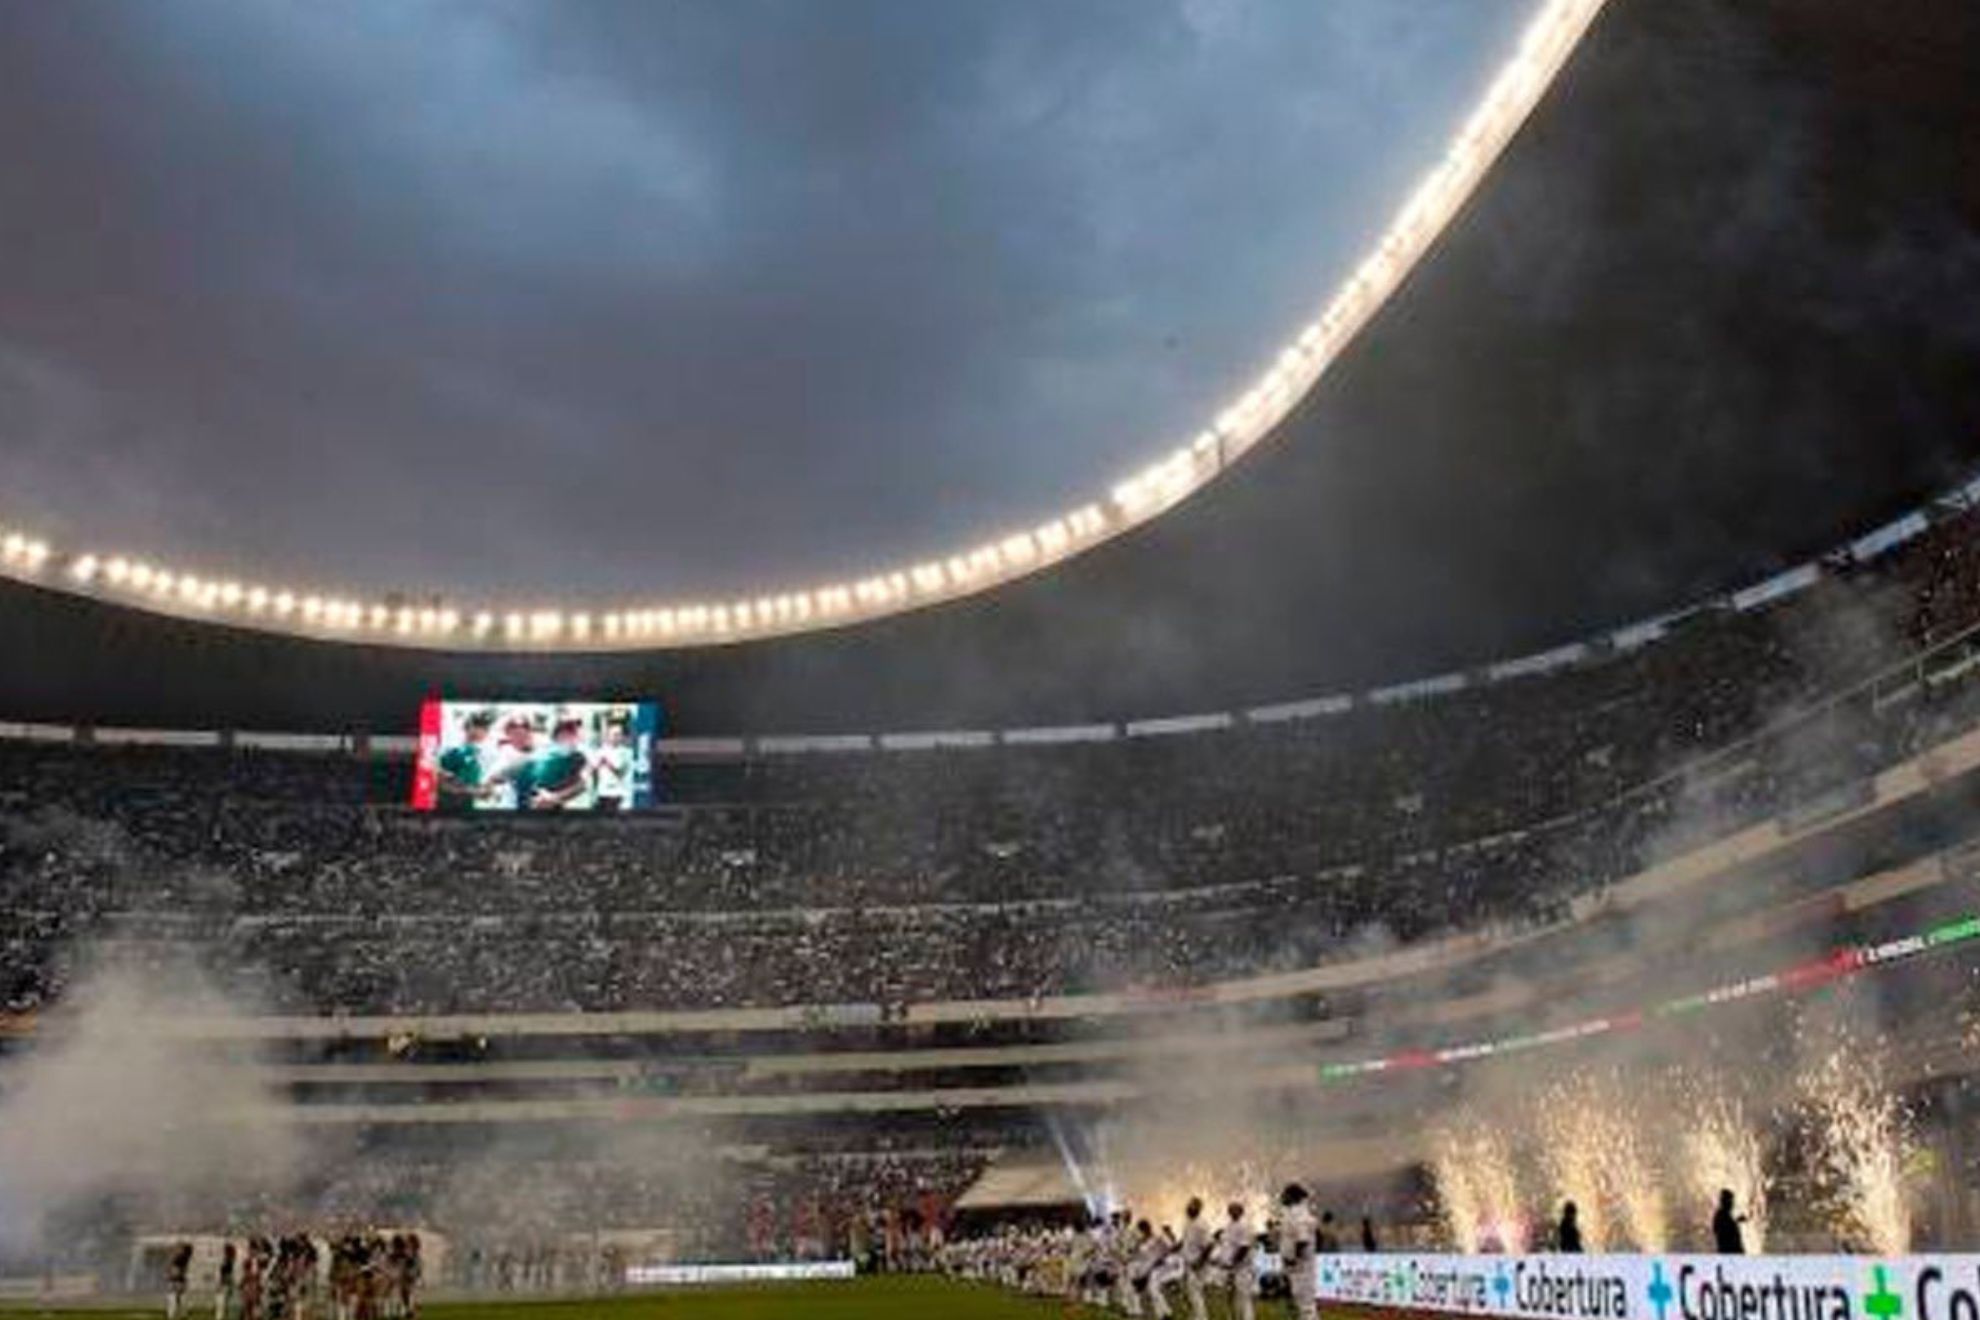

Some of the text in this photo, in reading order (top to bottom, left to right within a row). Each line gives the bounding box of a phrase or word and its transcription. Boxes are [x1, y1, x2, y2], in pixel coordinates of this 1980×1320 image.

[1516, 1261, 1627, 1318] Cobertura
[1679, 1264, 1850, 1320] Cobertura
[1917, 1266, 1980, 1320] Co
